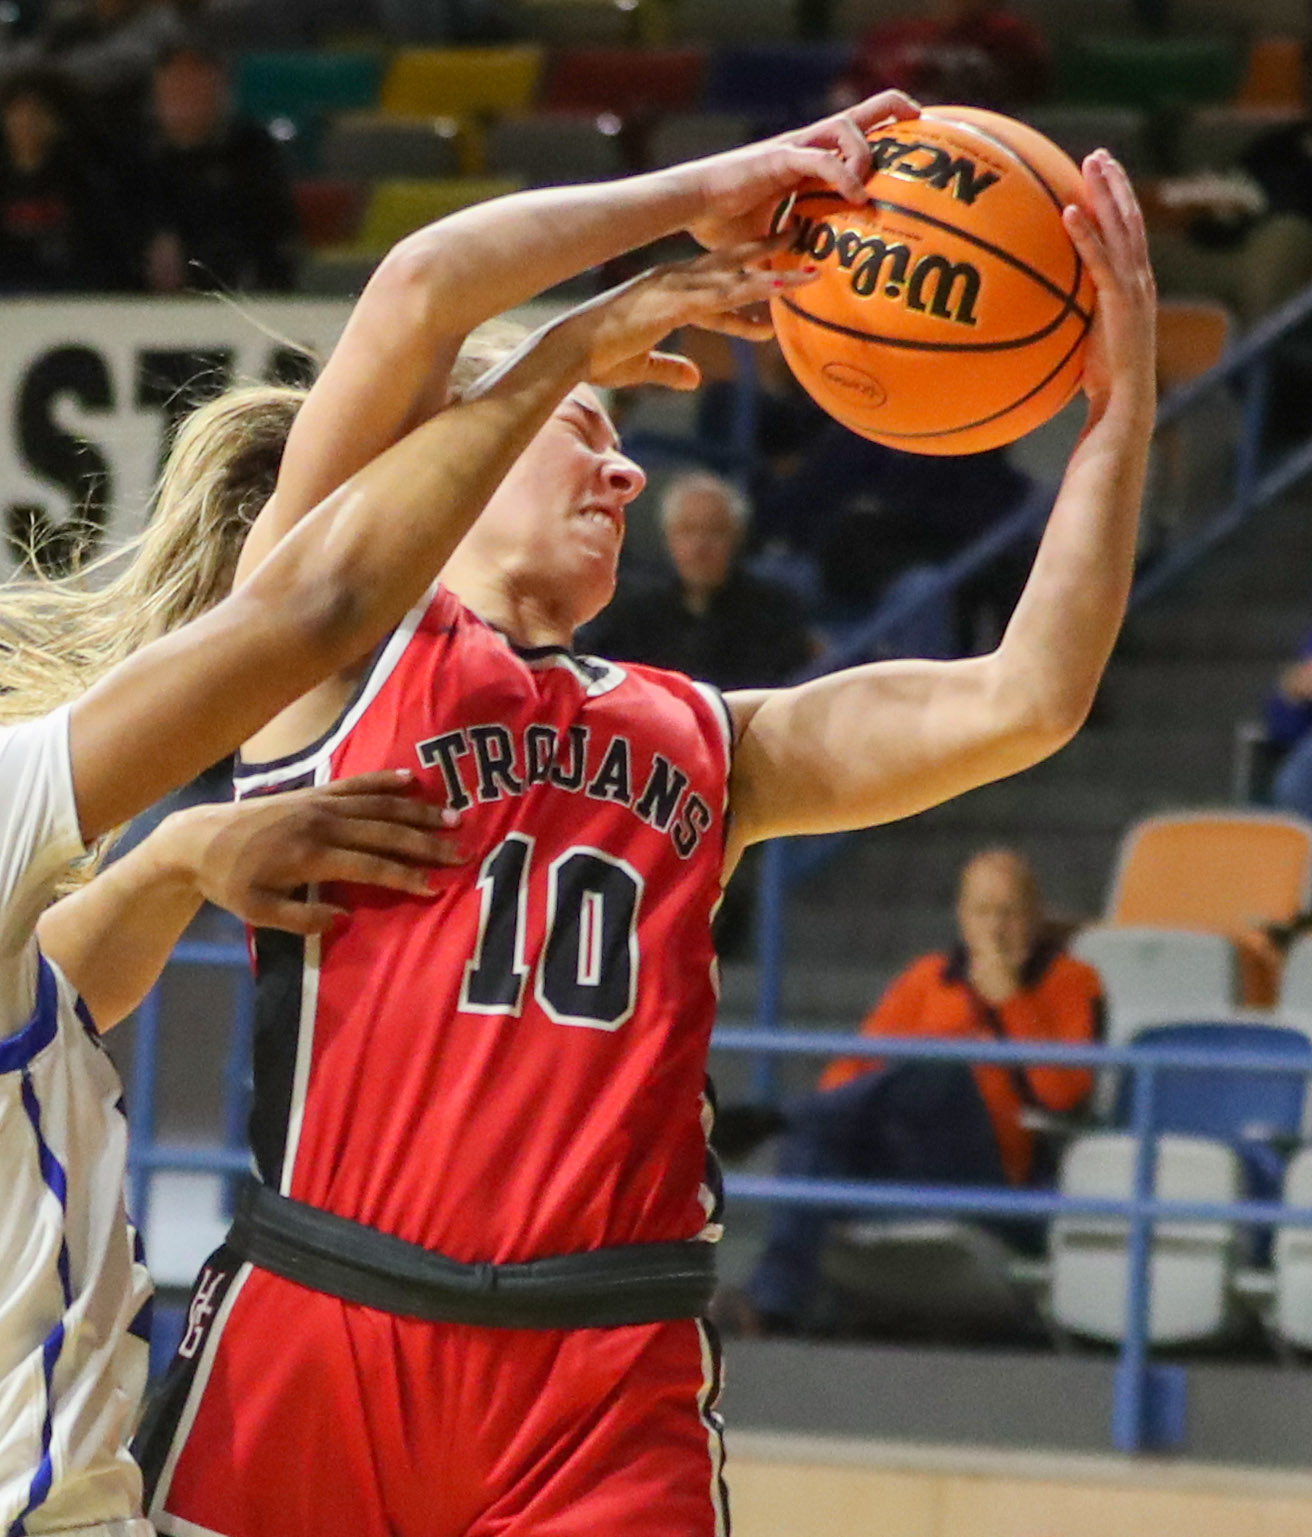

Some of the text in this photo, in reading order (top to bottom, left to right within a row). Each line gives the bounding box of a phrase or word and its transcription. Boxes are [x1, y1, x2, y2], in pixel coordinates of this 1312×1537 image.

[868, 137, 1000, 206] NCA
[4, 340, 318, 582] ST
[416, 723, 713, 860] TROJANS
[457, 830, 645, 1032] 10
